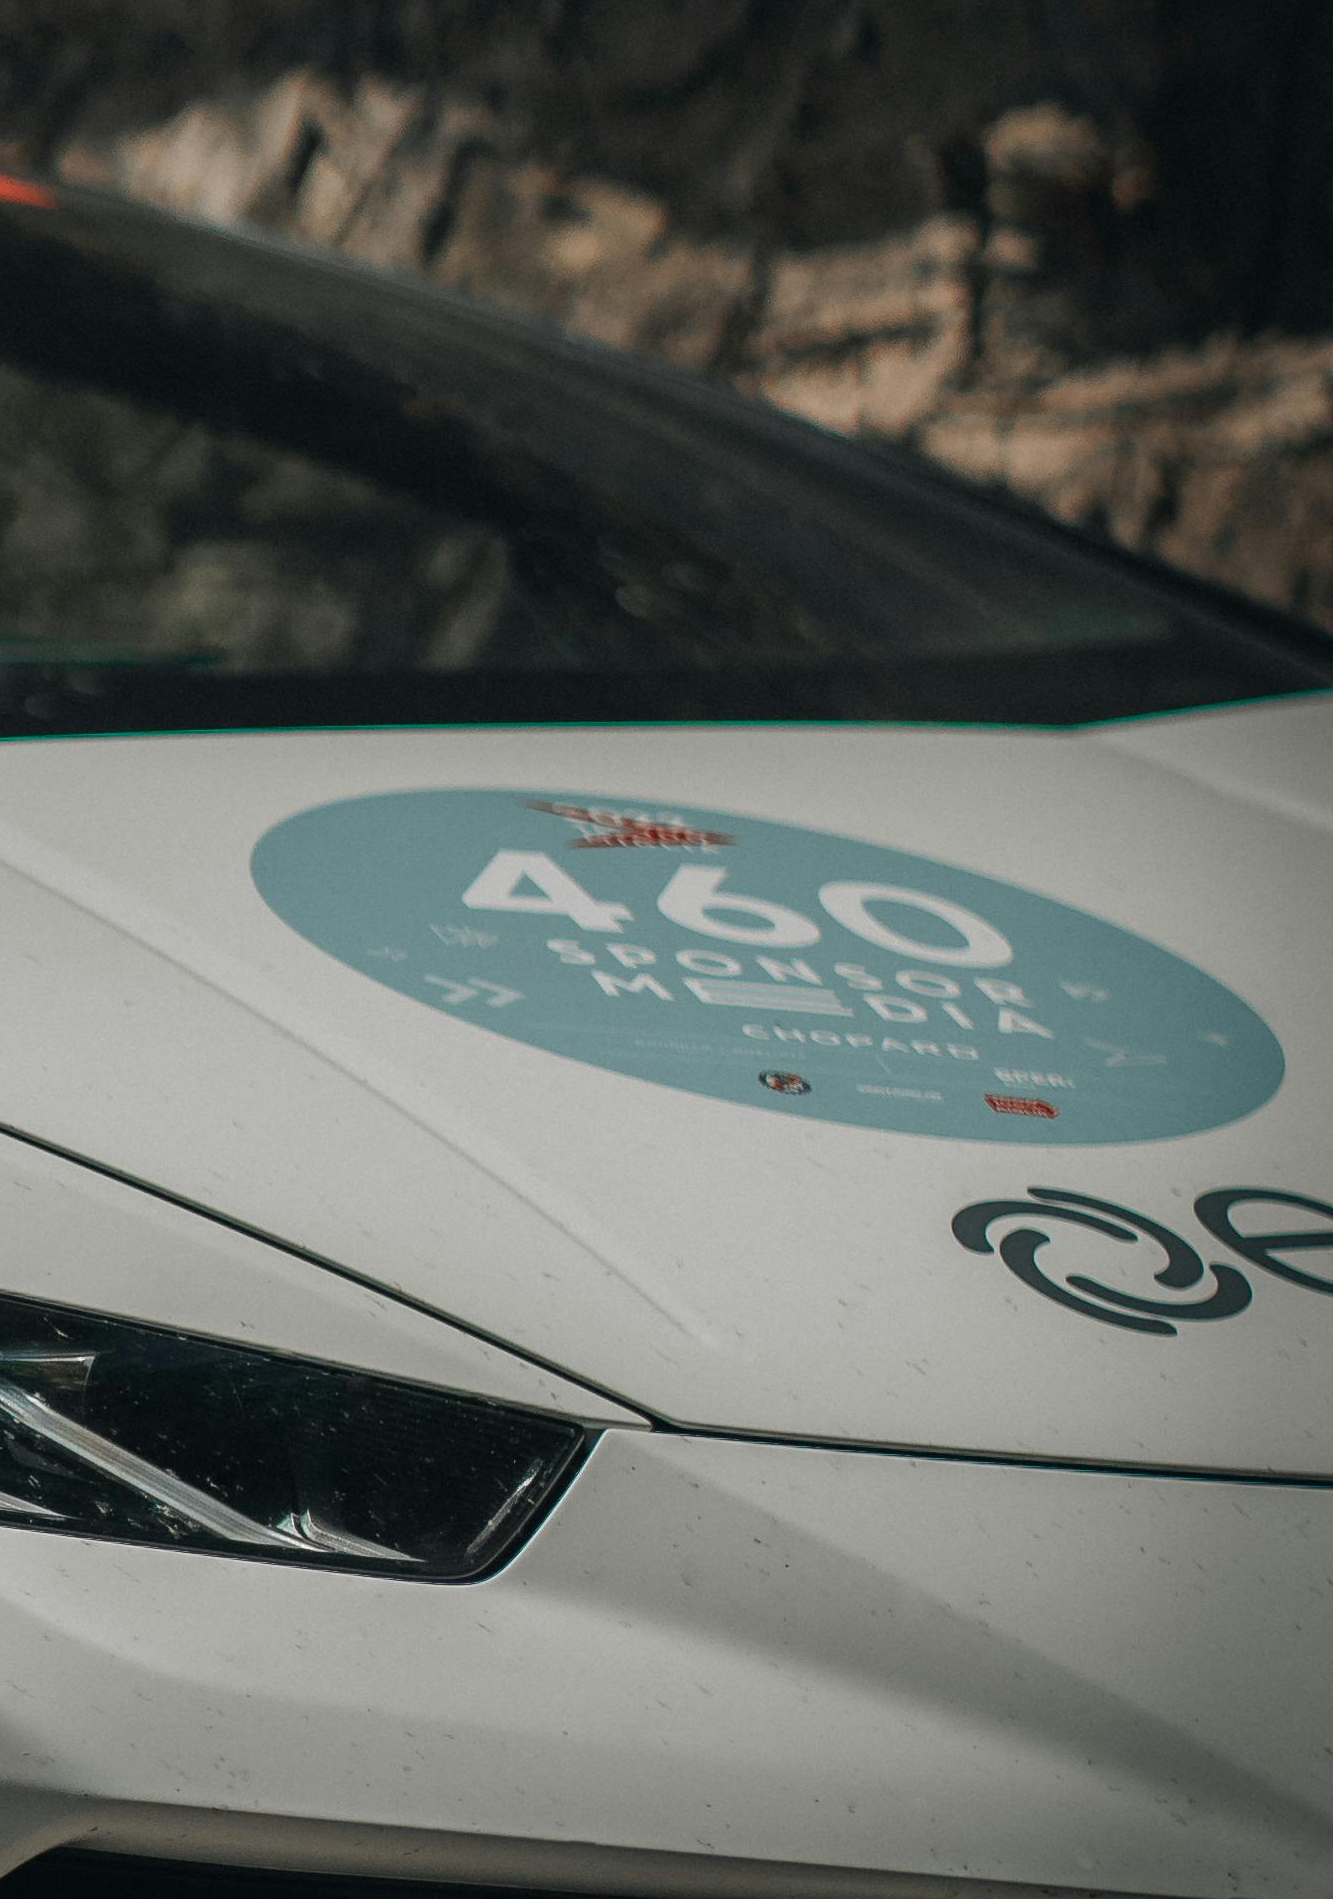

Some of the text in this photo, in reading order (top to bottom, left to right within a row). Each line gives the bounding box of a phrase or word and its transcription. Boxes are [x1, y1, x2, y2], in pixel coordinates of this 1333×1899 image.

[461, 849, 1014, 969] 460
[546, 938, 1032, 1008] SPONSOR
[590, 969, 1055, 1040] MEDIA
